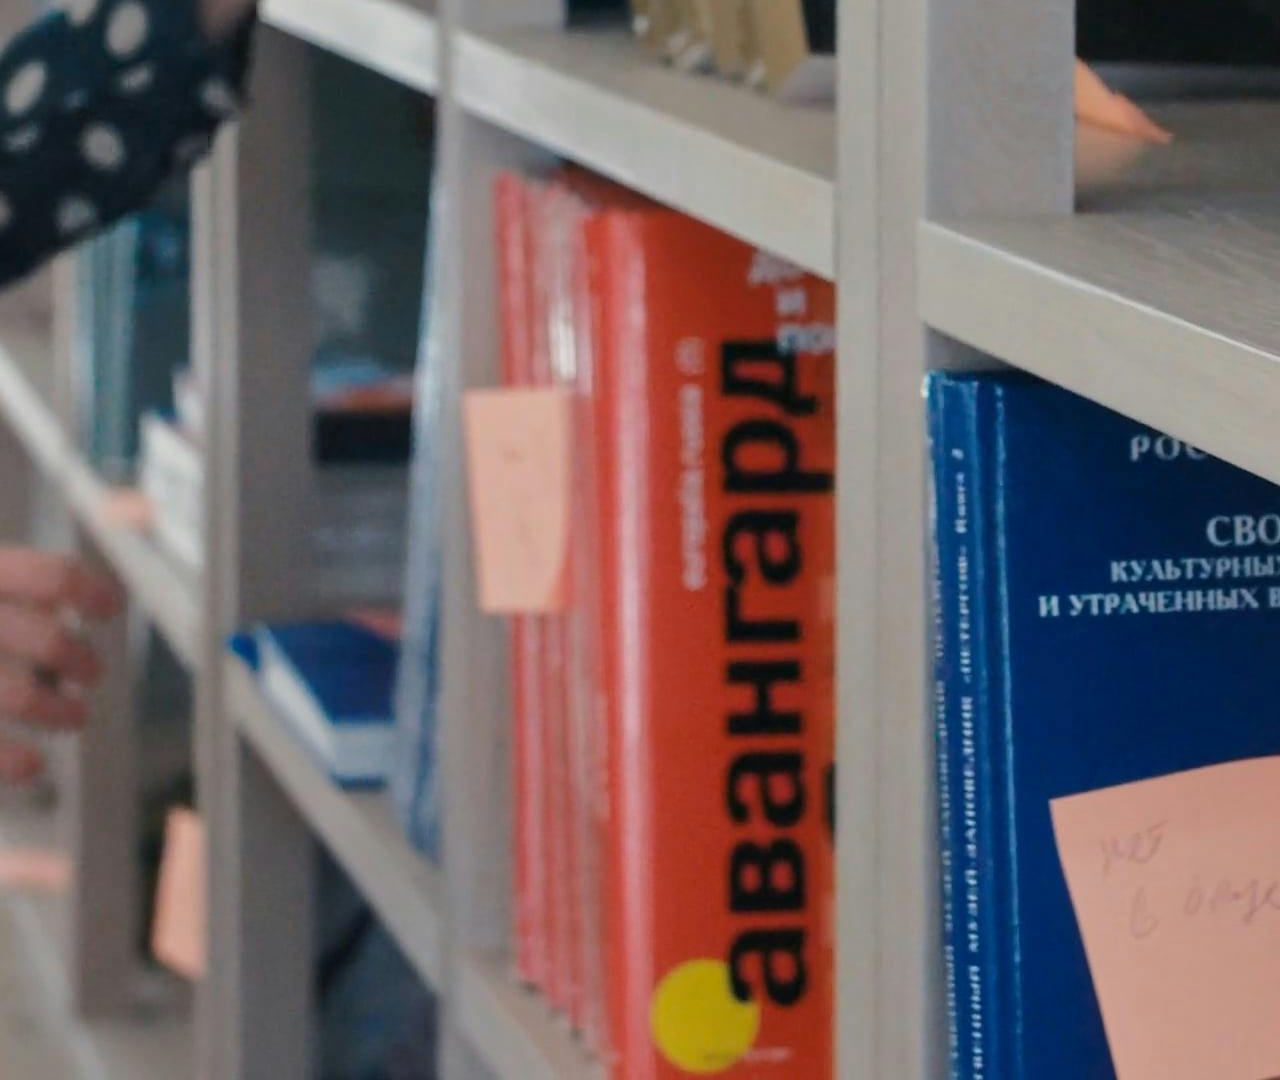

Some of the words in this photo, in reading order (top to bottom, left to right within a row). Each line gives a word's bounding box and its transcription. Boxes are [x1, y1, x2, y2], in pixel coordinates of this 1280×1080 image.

[720, 338, 833, 1007] авангард
[1038, 594, 1060, 618] И
[1069, 587, 1260, 617] УТРАЧЕННЫХ
